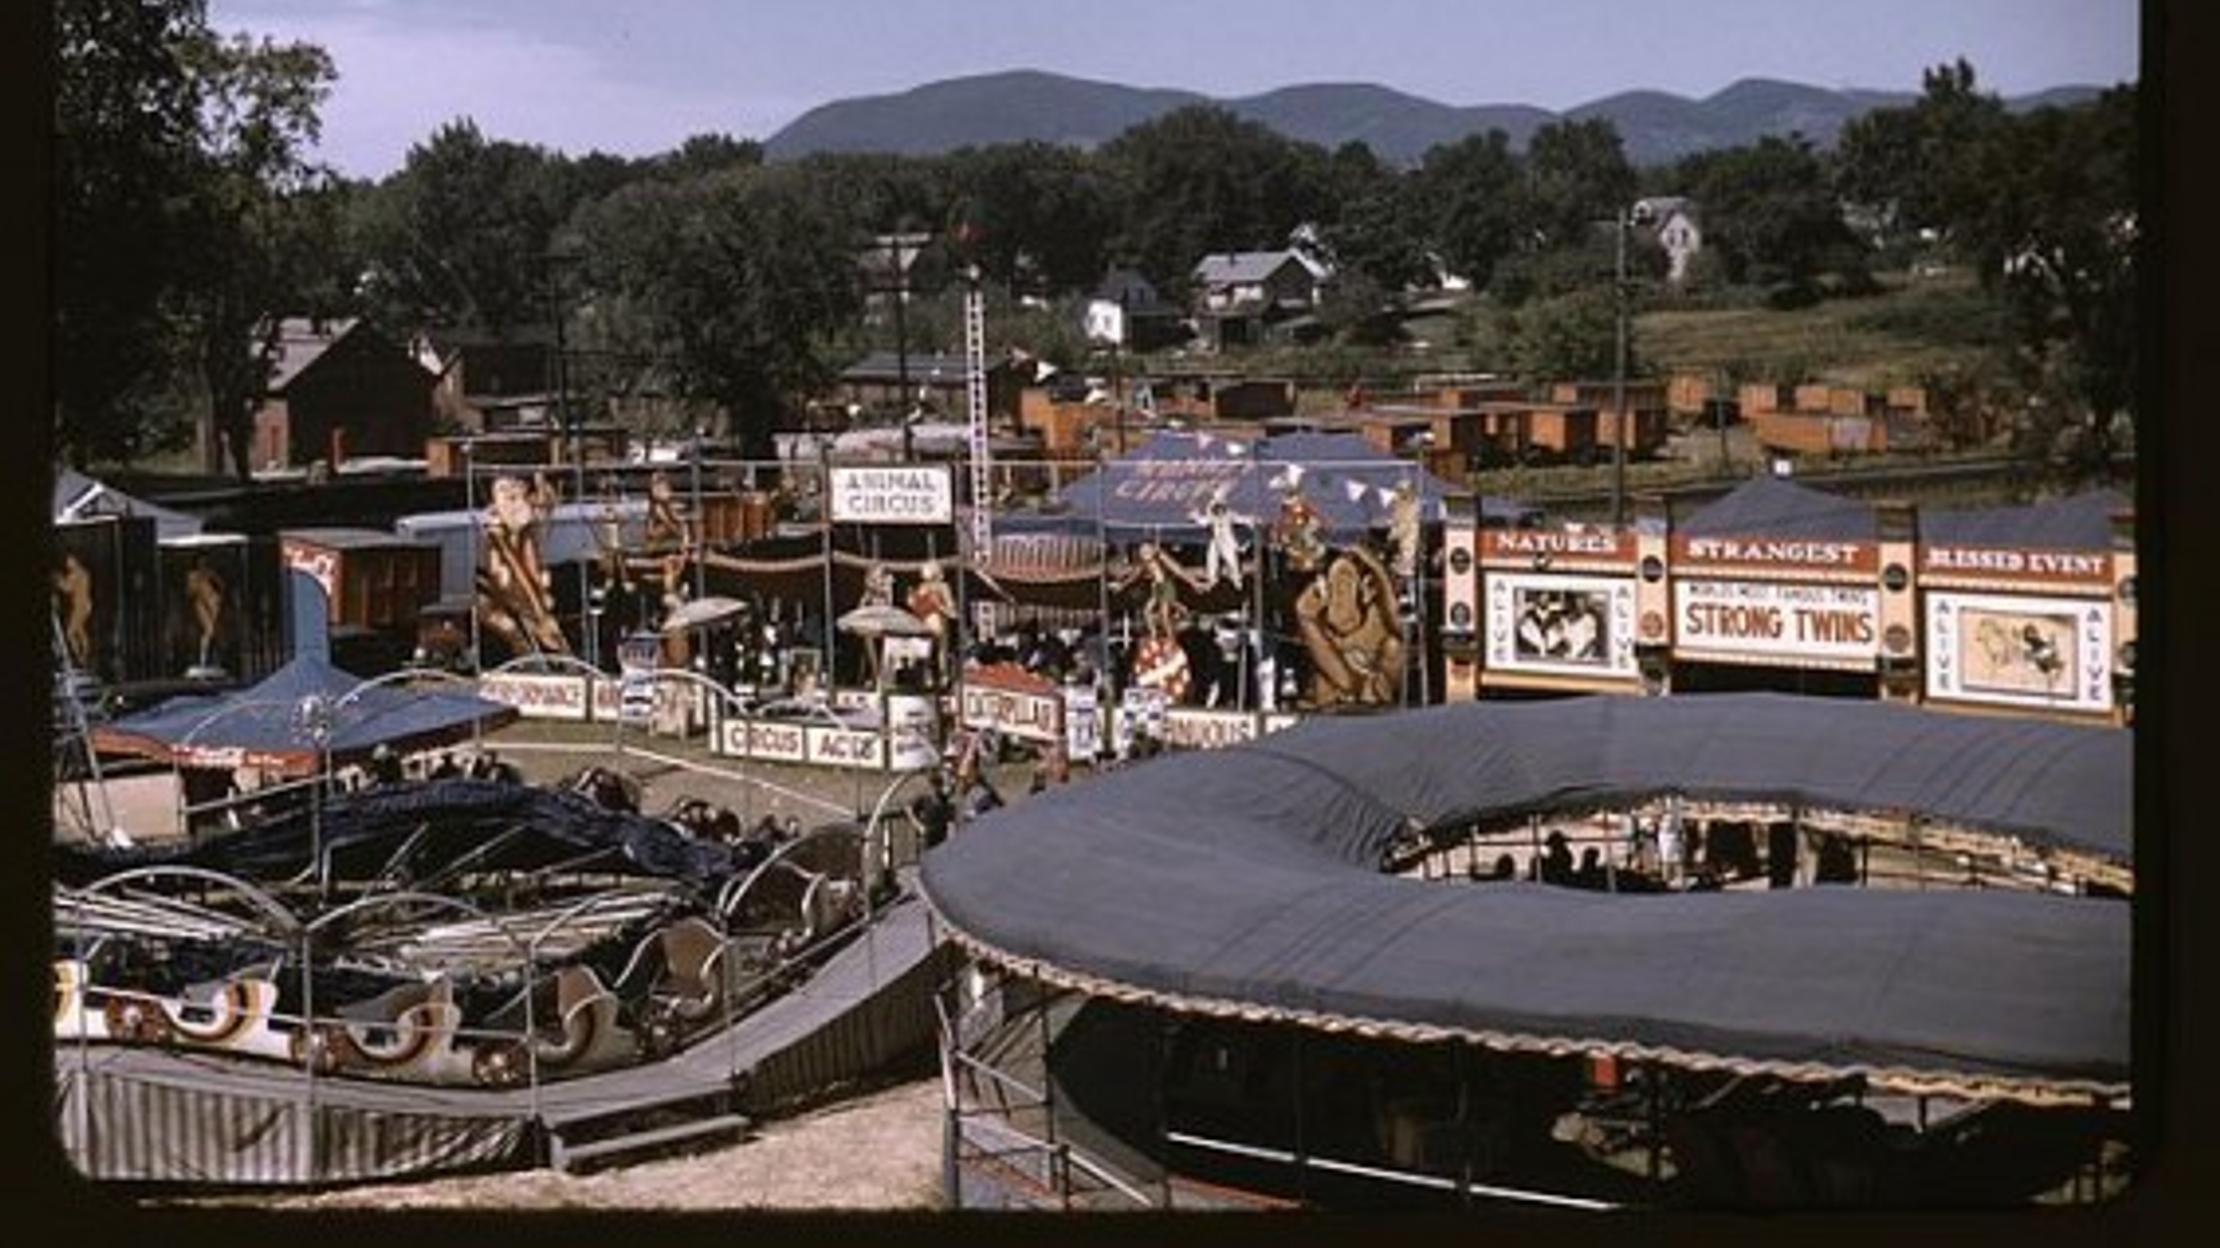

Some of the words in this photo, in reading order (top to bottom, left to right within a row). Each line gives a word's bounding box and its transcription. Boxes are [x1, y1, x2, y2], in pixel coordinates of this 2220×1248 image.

[847, 471, 936, 491] ANIMAL
[848, 494, 935, 513] CIRCUS
[1688, 538, 1859, 565] STRANGEST
[1927, 548, 2024, 571] BLESSED
[2028, 553, 2106, 575] EVENT
[1493, 577, 1507, 661] ALIVE
[1616, 585, 1631, 669] ALIVE
[1686, 601, 1783, 639] STRONG
[1793, 607, 1873, 644] TWINS
[1936, 600, 1950, 689] ALIVE
[2087, 607, 2103, 700] ALIVE
[730, 724, 799, 753] CIRCUS
